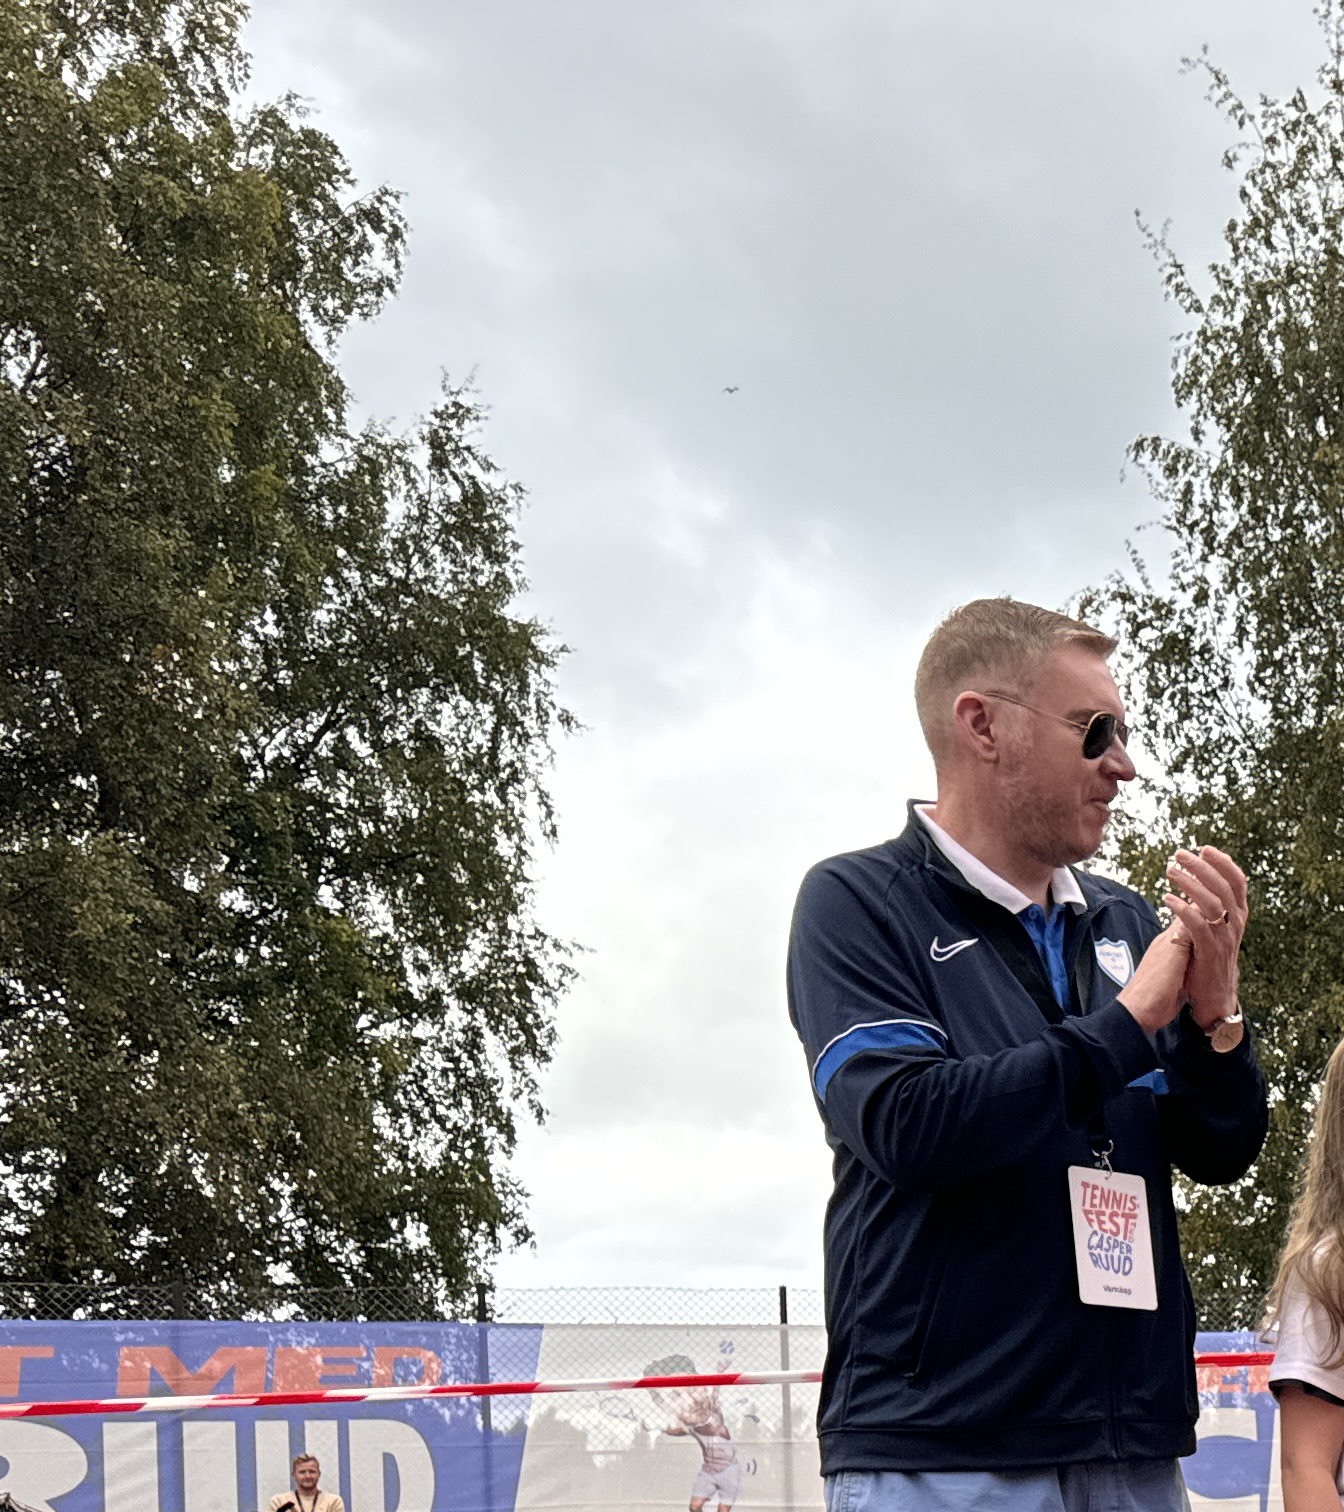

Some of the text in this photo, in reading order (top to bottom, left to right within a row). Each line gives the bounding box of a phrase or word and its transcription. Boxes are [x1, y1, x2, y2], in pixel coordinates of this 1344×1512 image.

[1081, 1208, 1138, 1241] FEST
[1087, 1229, 1133, 1256] CASPER
[1088, 1251, 1133, 1276] RUUD
[116, 1346, 441, 1397] MED
